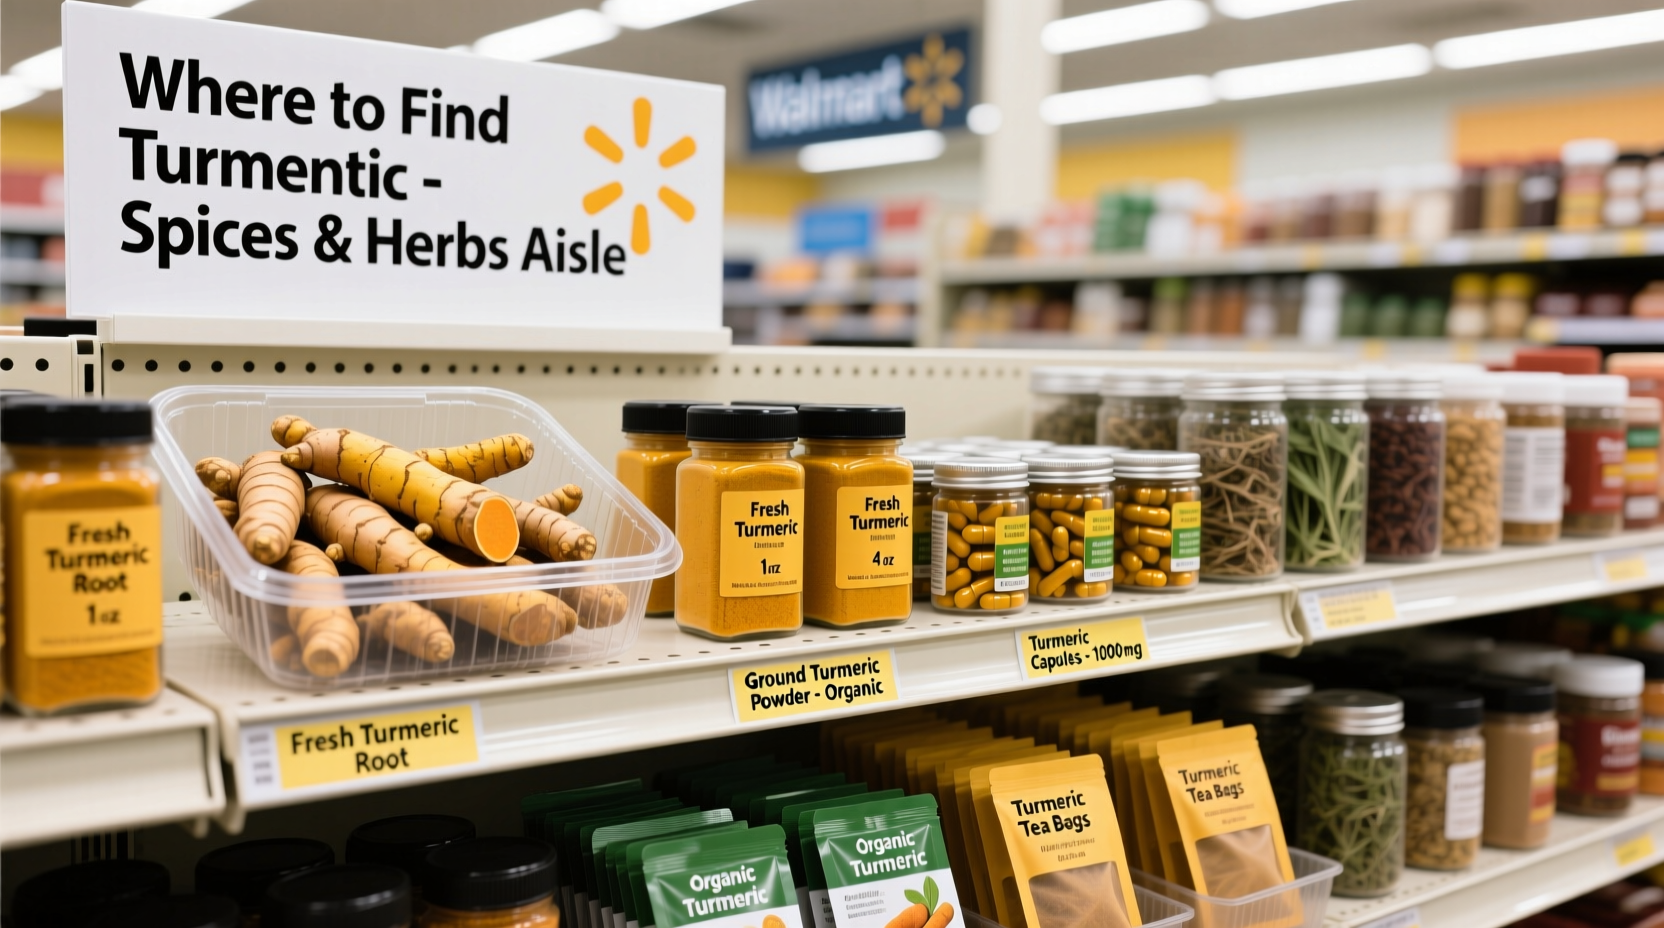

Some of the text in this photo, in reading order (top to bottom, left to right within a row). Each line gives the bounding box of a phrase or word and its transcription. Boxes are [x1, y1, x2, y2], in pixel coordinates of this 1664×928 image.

[119, 51, 509, 144] Where to Find
[749, 54, 903, 139] Walmart
[119, 127, 442, 201] Turmentic -
[121, 200, 626, 276] Spices & Herbs Aisle
[750, 499, 789, 518] Fresh
[865, 495, 900, 512] Fresh
[68, 521, 130, 544] Fresh
[734, 519, 798, 538] Turmeric
[849, 512, 909, 530] Turmeric
[45, 543, 149, 570] Turmeric
[872, 551, 895, 566] 4 oz
[73, 572, 128, 594] Root
[86, 604, 96, 625] 1
[1028, 628, 1089, 653] Turmeric
[1093, 641, 1142, 663] 1000mg
[744, 657, 881, 690] Ground Turmeric
[750, 688, 809, 711] Powder
[825, 678, 884, 704] Organic
[291, 713, 459, 754] Fresh Turmeric
[355, 747, 410, 773] Root
[1178, 760, 1241, 786] Turmeric
[1011, 790, 1086, 817] Turmeric
[1186, 787, 1213, 804] Tea
[1018, 813, 1091, 838] Tea Bags
[856, 830, 915, 856] Organic
[850, 849, 928, 878] Turmeric
[689, 865, 756, 894] Organic
[682, 885, 768, 918] Turmeric
